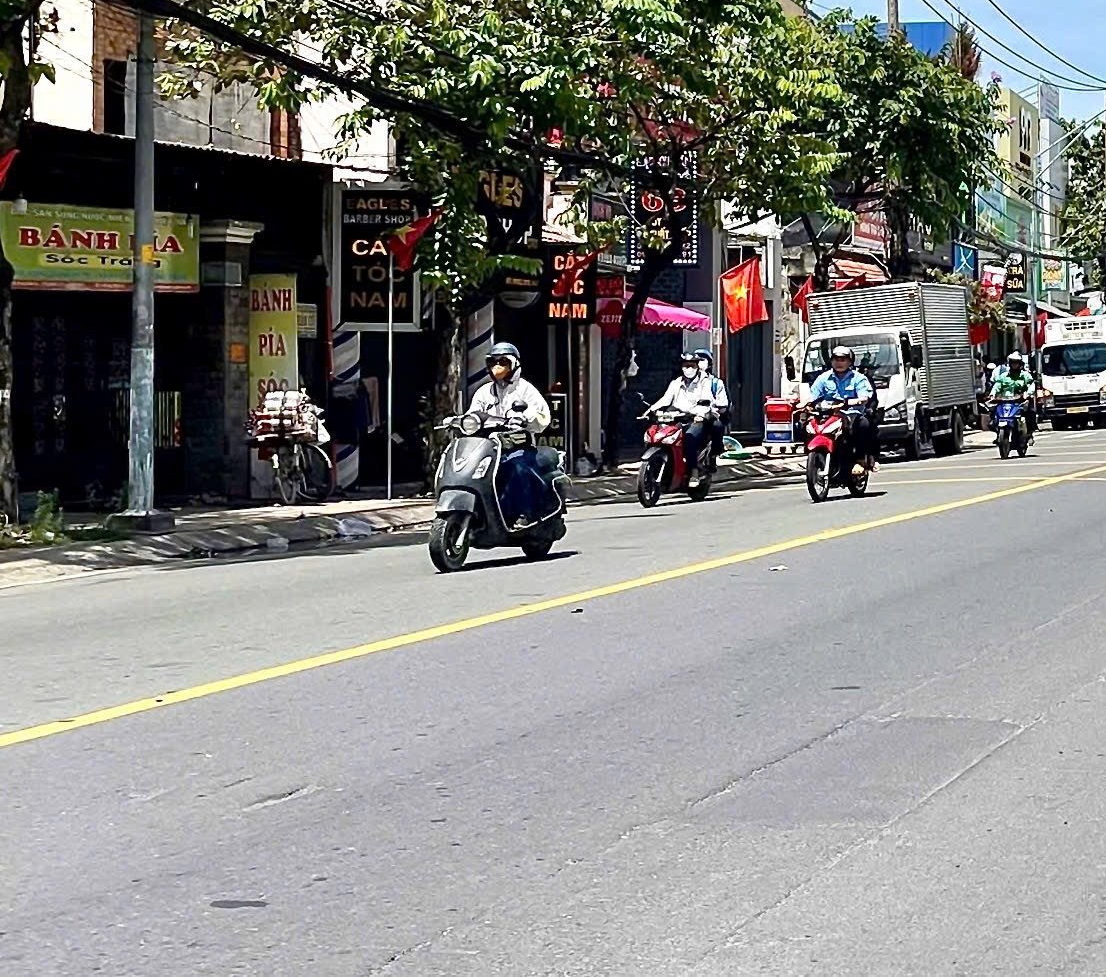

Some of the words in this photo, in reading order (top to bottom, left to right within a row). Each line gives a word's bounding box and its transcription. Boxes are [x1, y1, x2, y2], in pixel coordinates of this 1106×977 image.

[346, 198, 411, 210] EAGLES
[343, 214, 382, 224] BARBER
[384, 215, 411, 224] SHOP
[18, 223, 120, 251] BÁNH
[129, 229, 185, 253] ÍA
[252, 282, 292, 312] BÁNH
[350, 291, 407, 308] NAM
[549, 303, 588, 319] NAM
[258, 326, 287, 357] PÍA
[538, 436, 564, 447] AM
